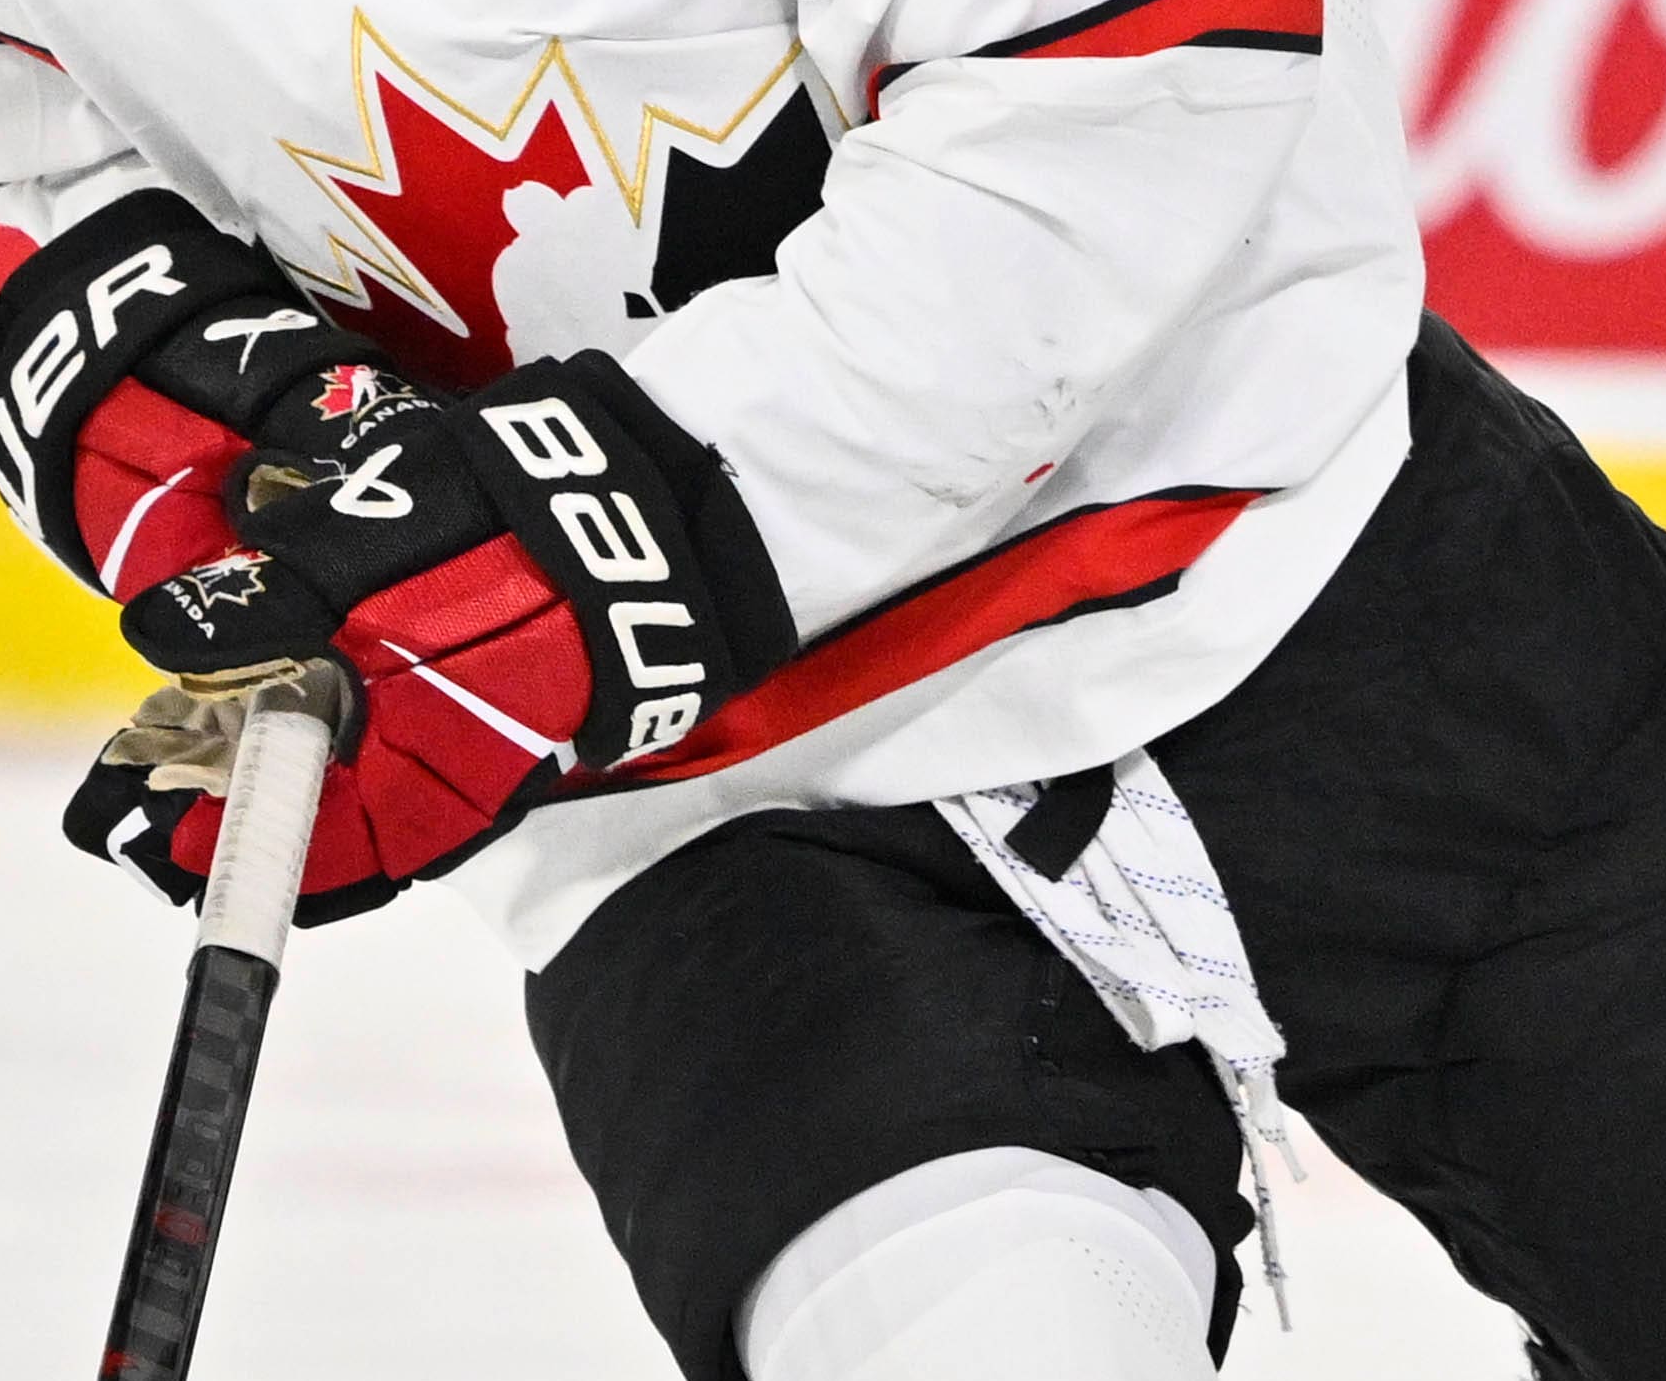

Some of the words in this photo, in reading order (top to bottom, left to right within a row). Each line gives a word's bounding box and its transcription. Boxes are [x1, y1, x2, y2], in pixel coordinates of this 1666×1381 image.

[341, 399, 445, 449] CANAD
[162, 581, 215, 639] NADA
[479, 397, 706, 772] BAUE
